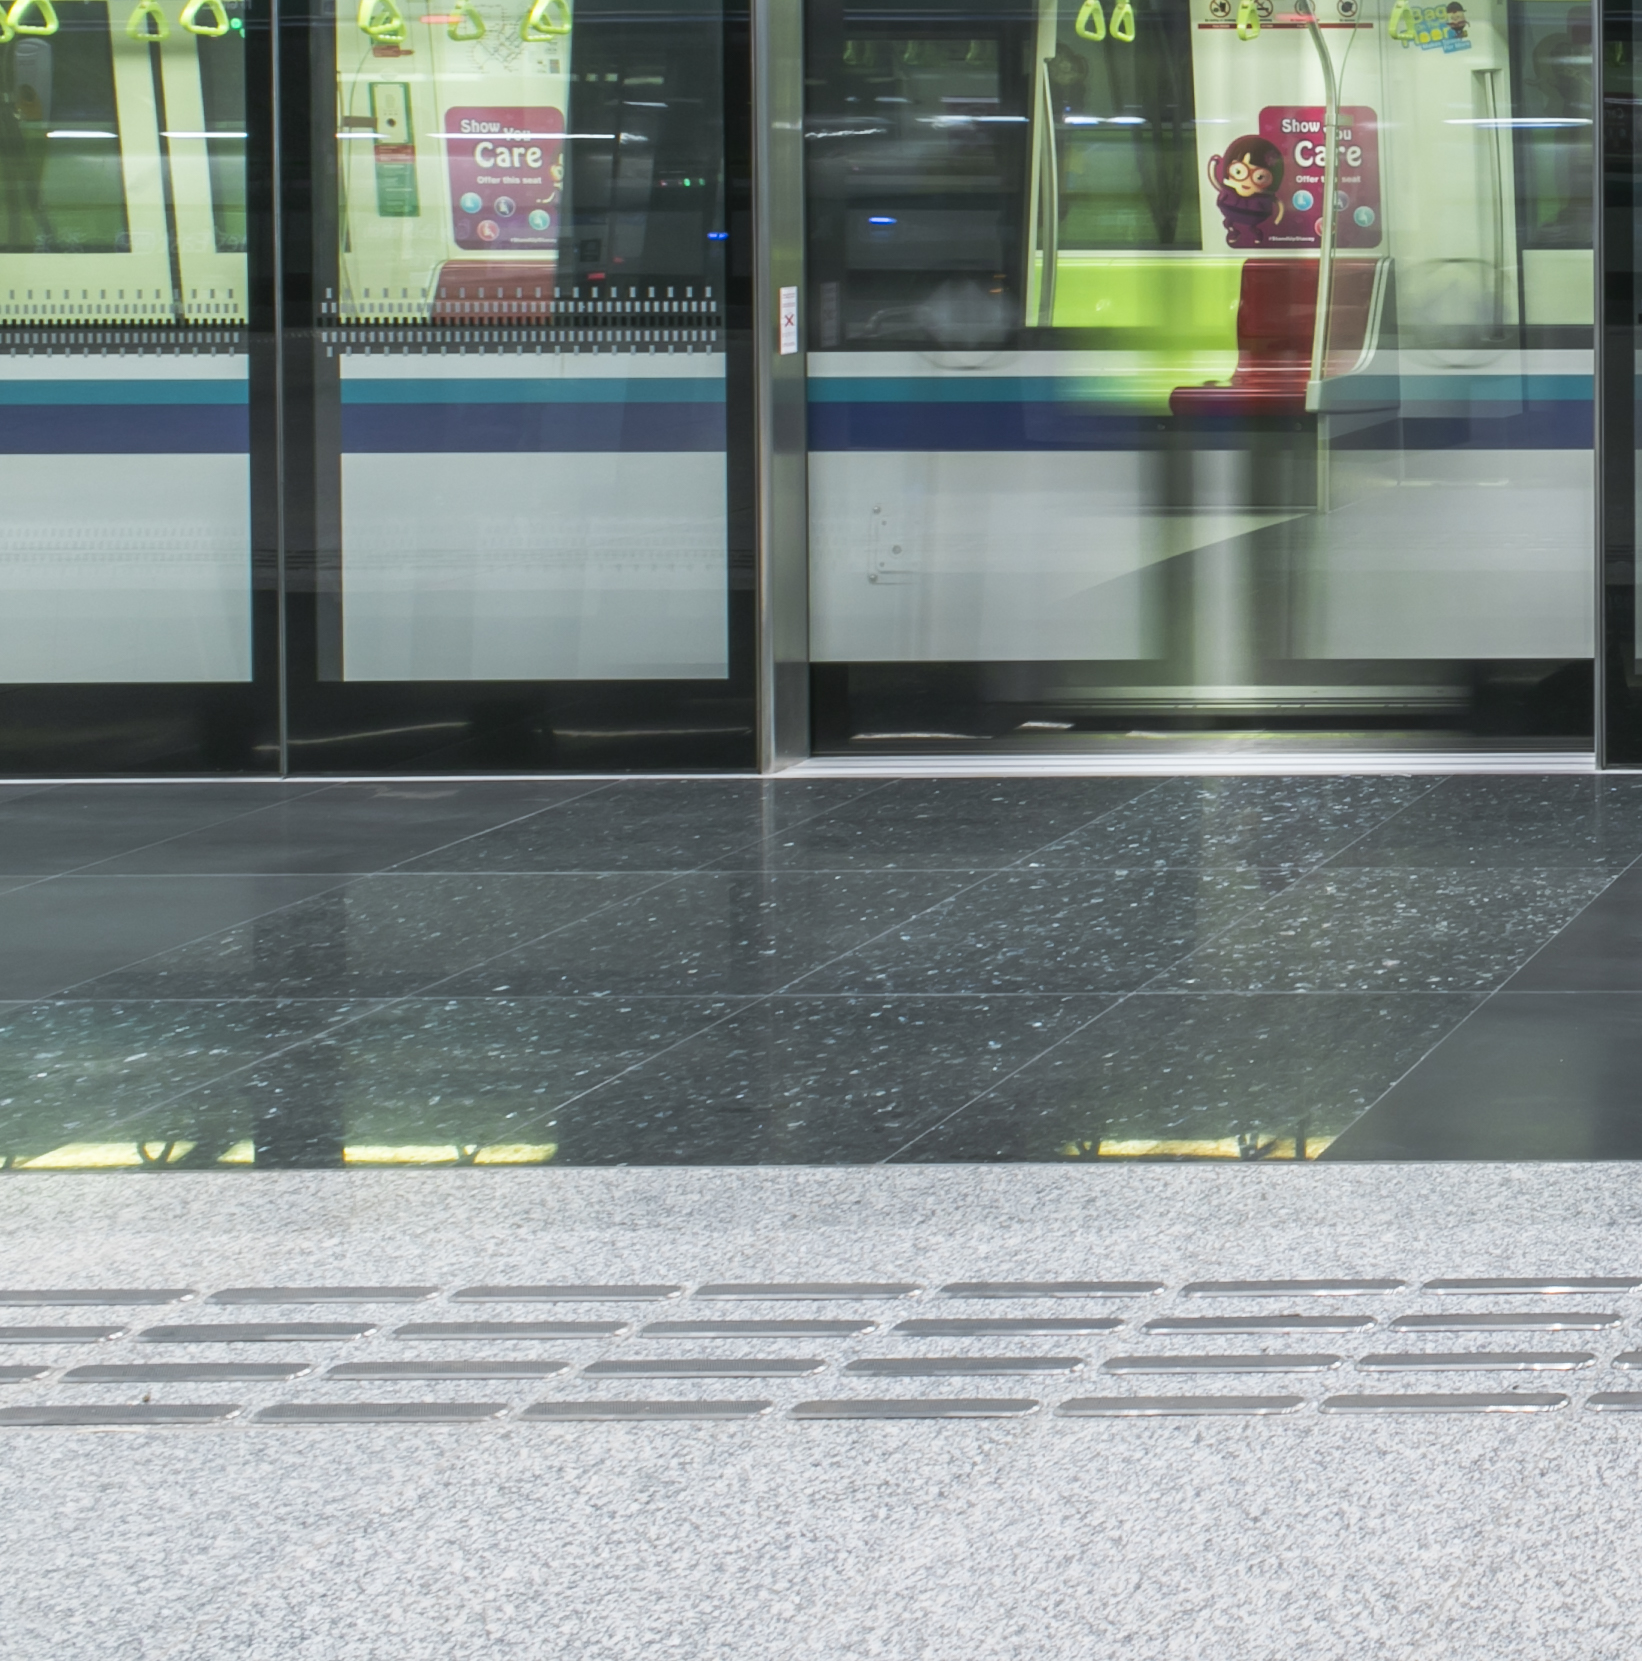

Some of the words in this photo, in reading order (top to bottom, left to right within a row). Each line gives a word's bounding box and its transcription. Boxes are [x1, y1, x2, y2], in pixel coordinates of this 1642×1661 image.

[460, 119, 501, 133] Show
[1281, 118, 1321, 133] Show
[474, 141, 543, 168] Care
[1295, 175, 1320, 184] Offer
